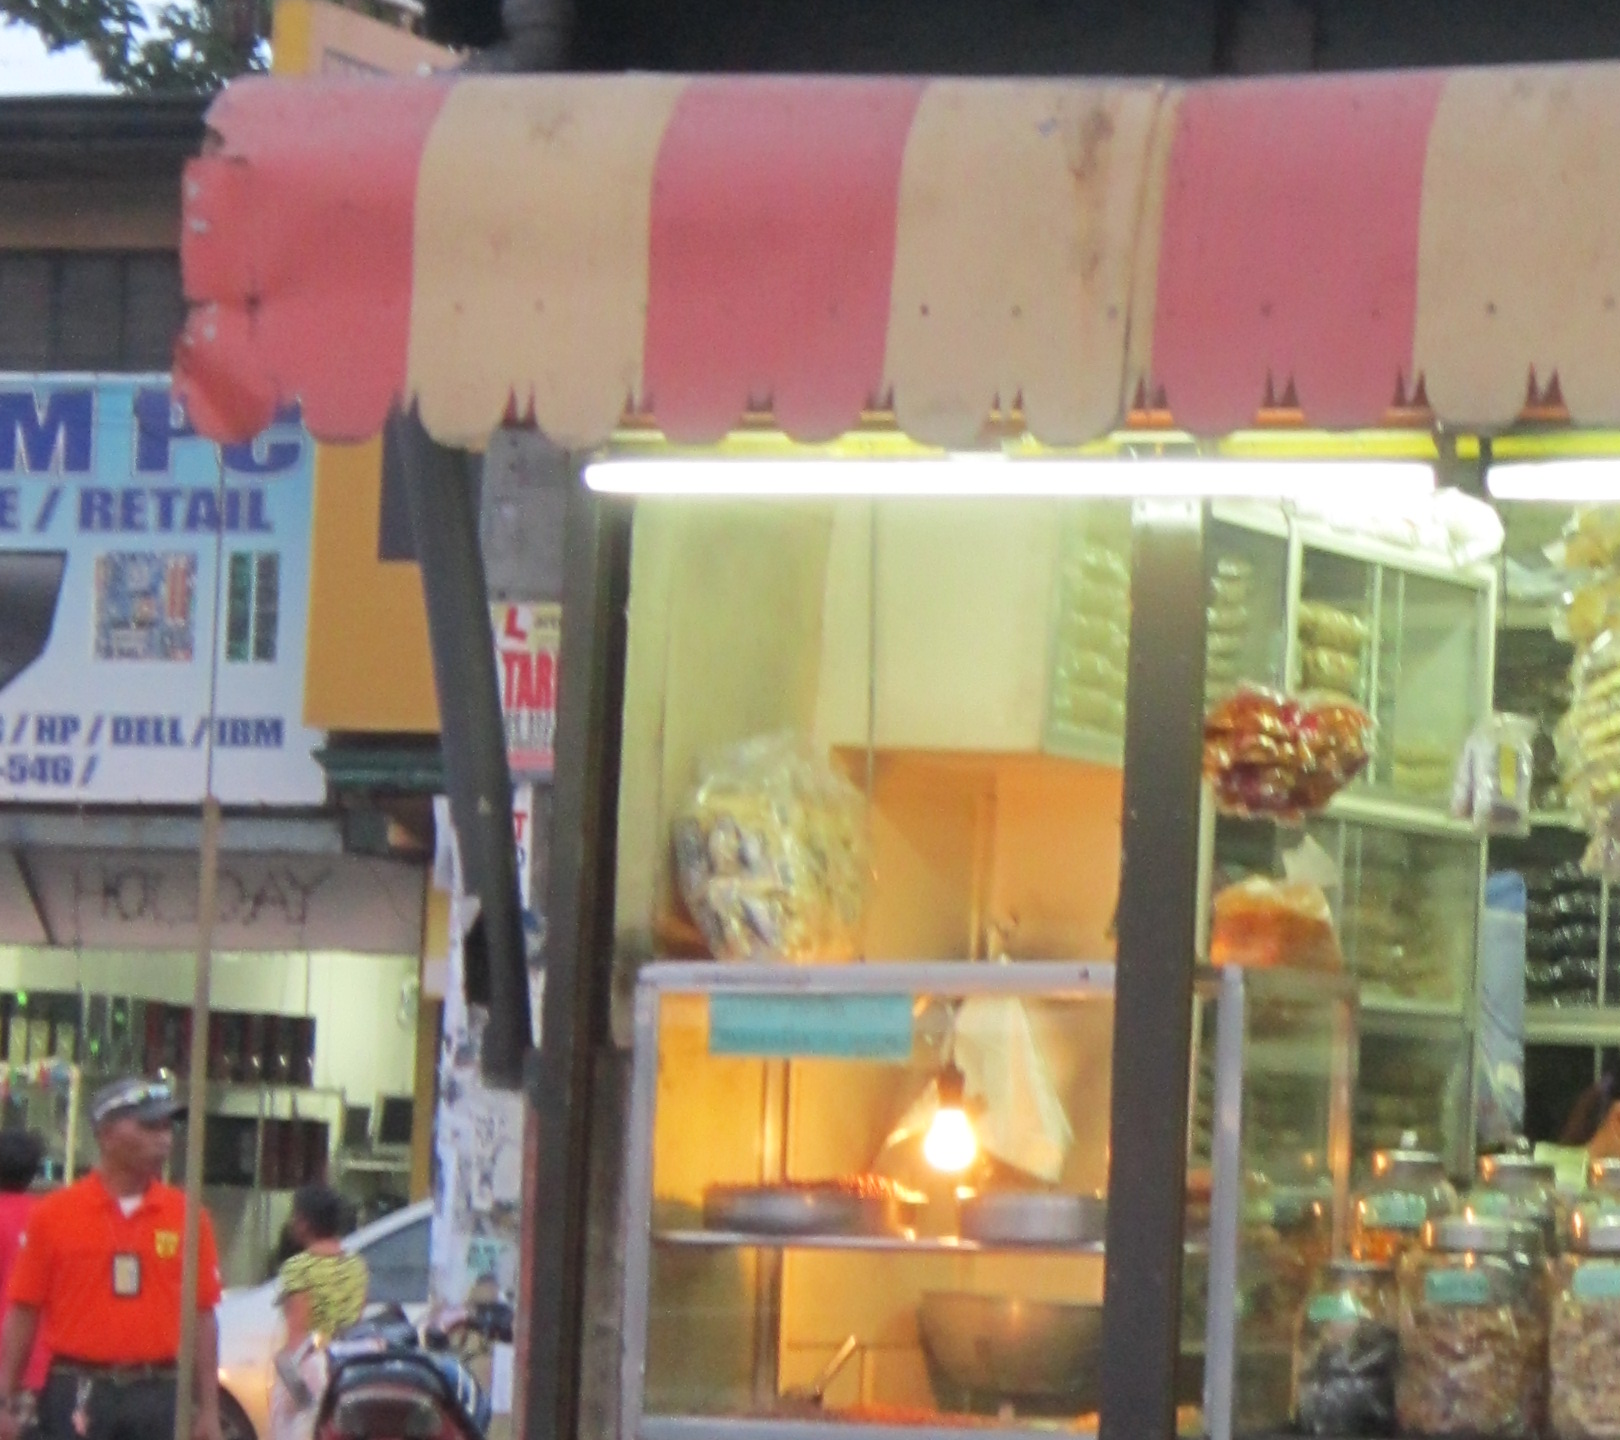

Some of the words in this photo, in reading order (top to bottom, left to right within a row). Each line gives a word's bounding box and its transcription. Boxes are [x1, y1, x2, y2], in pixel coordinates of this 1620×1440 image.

[79, 486, 273, 533] RETAIL
[36, 714, 81, 744] HP
[112, 716, 185, 747] DELL
[217, 718, 284, 748] IBM
